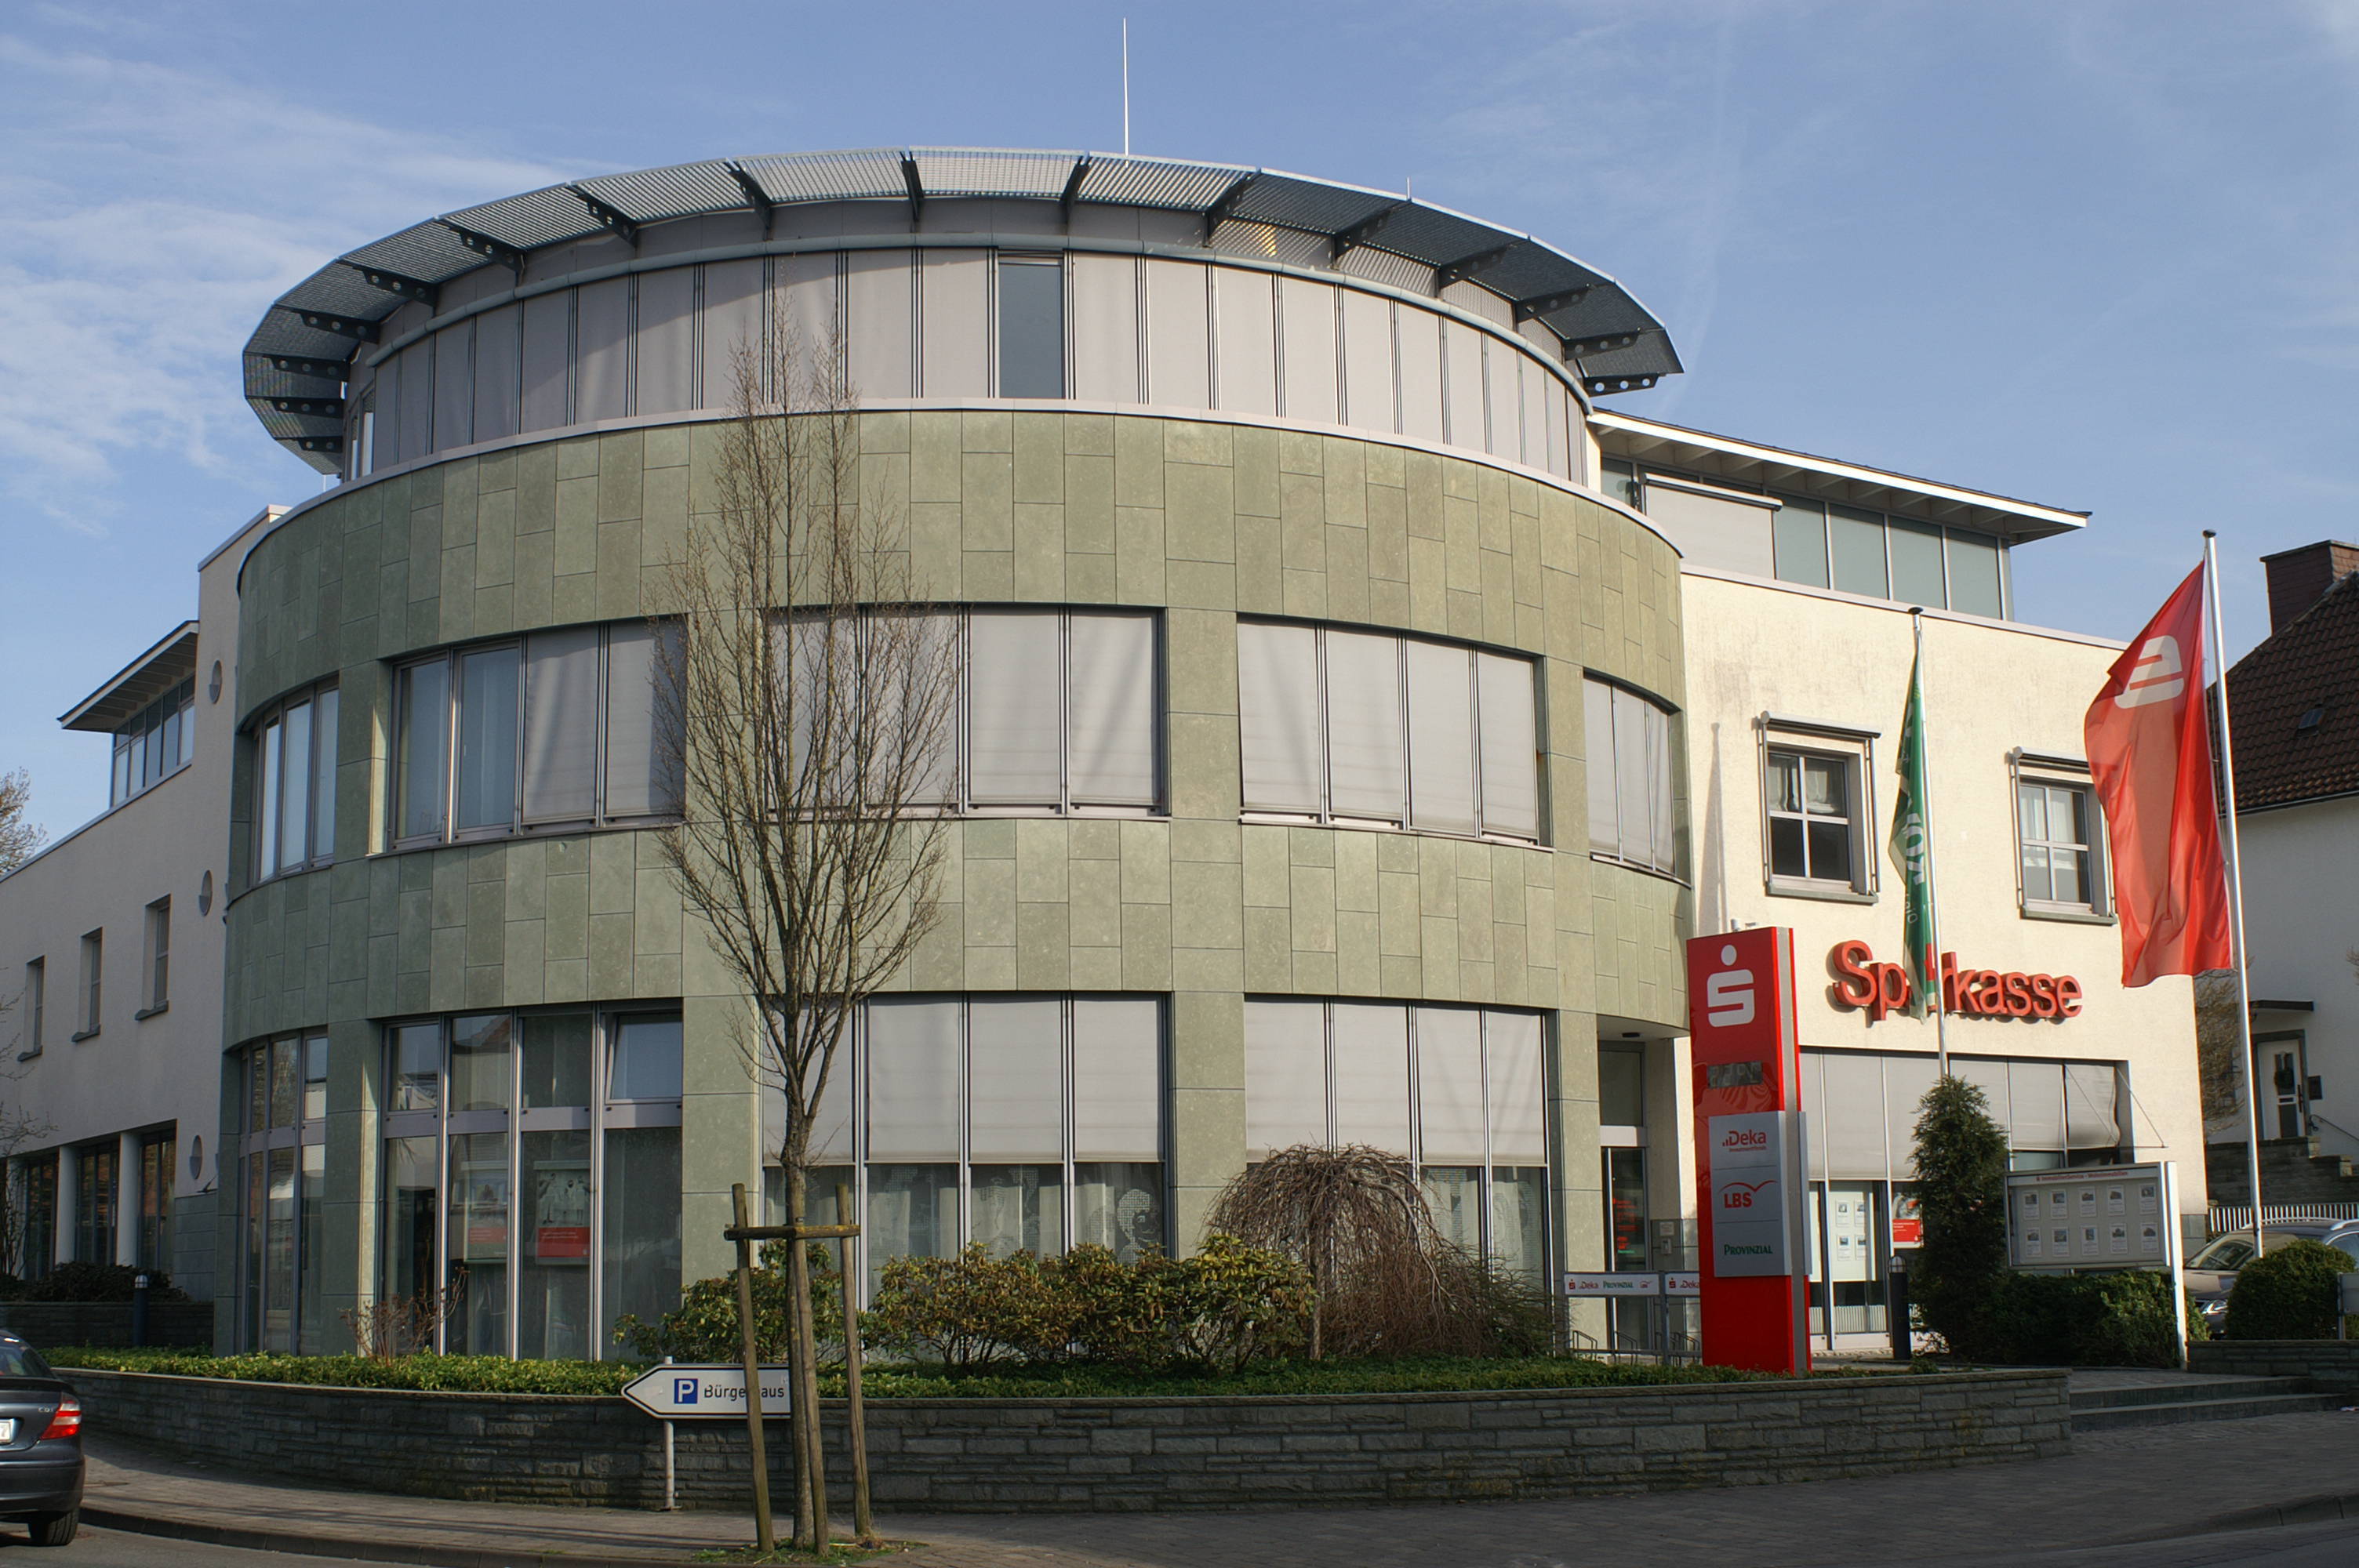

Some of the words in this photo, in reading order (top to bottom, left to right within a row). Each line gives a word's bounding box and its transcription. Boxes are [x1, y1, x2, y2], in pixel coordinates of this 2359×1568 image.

[1833, 939, 2083, 1021] Spkasse
[1728, 1129, 1767, 1146] Deka
[1724, 1192, 1753, 1208] LBS
[703, 1385, 785, 1402] Bürgeaus
